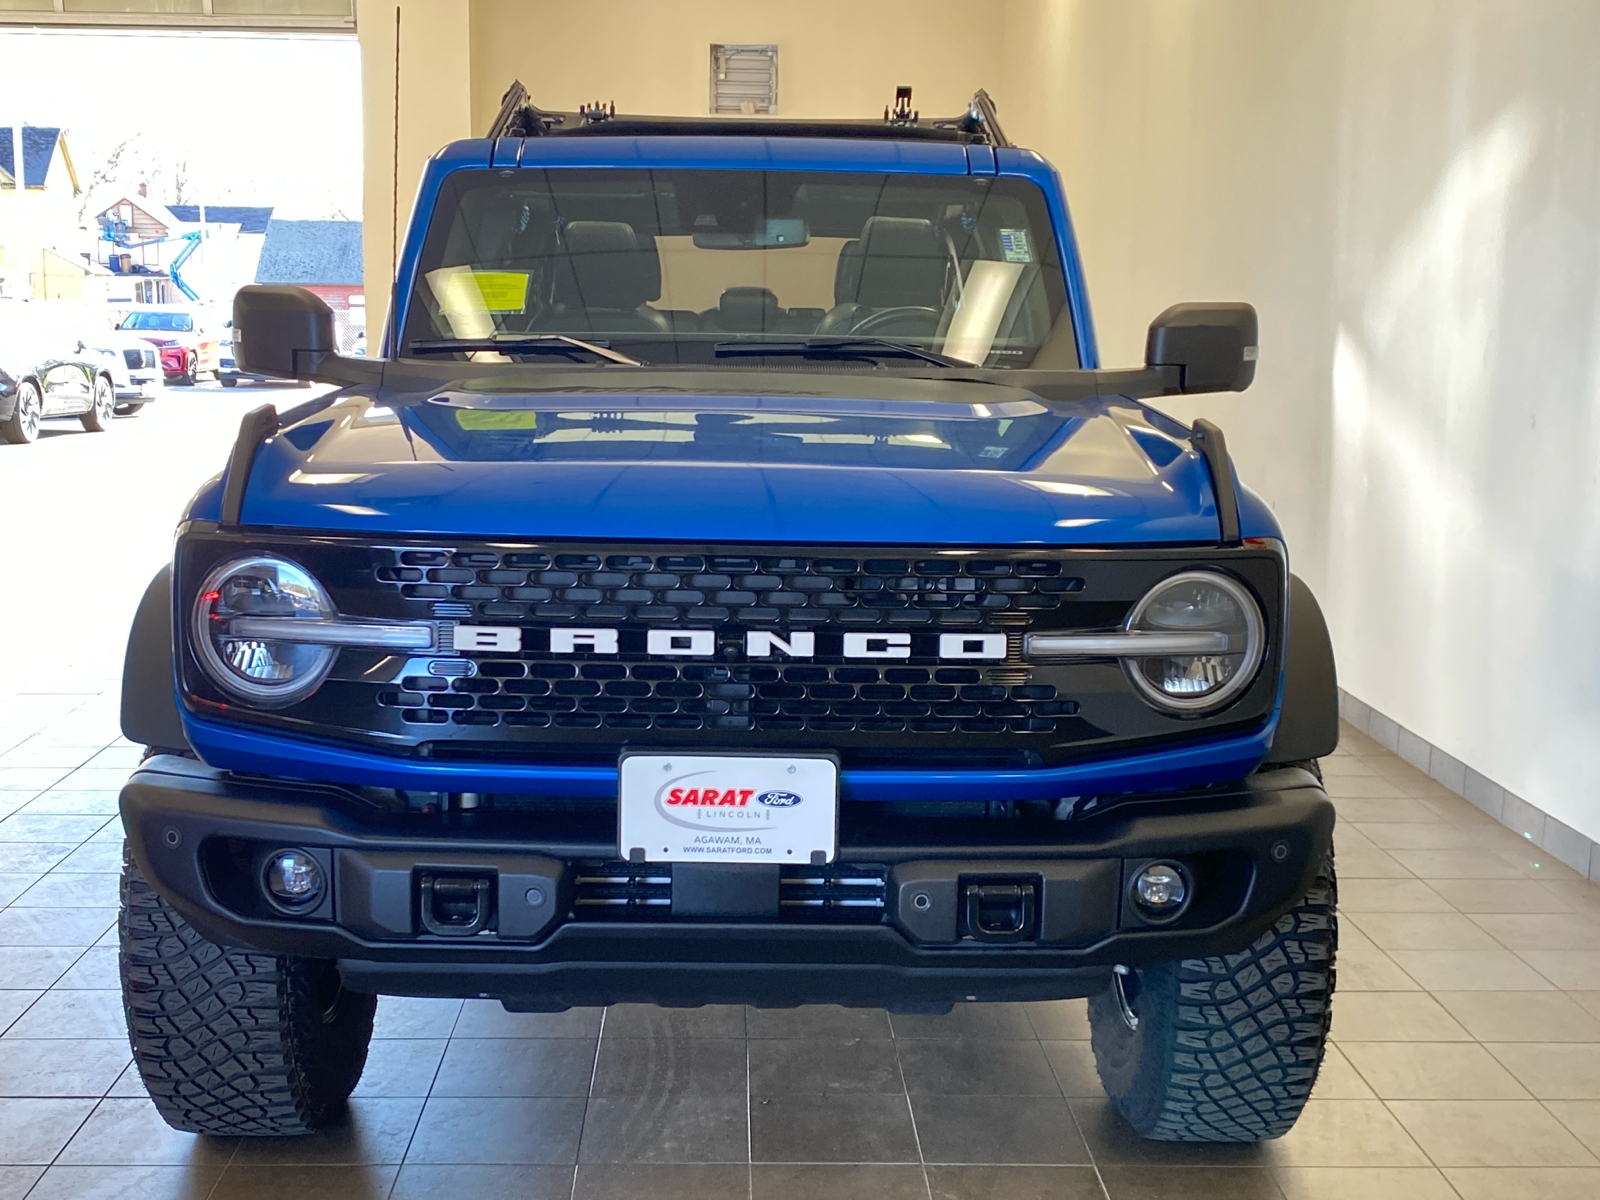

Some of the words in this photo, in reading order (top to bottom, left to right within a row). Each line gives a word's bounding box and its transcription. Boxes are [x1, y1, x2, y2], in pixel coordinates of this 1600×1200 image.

[453, 626, 1007, 659] BRONCO
[666, 787, 756, 807] SARAT
[763, 791, 797, 807] Ford
[706, 810, 762, 819] LINCOLN
[694, 836, 743, 845] AGAWAM,
[746, 837, 762, 845] MA
[683, 847, 772, 855] WWW.SARATFORD.COM
